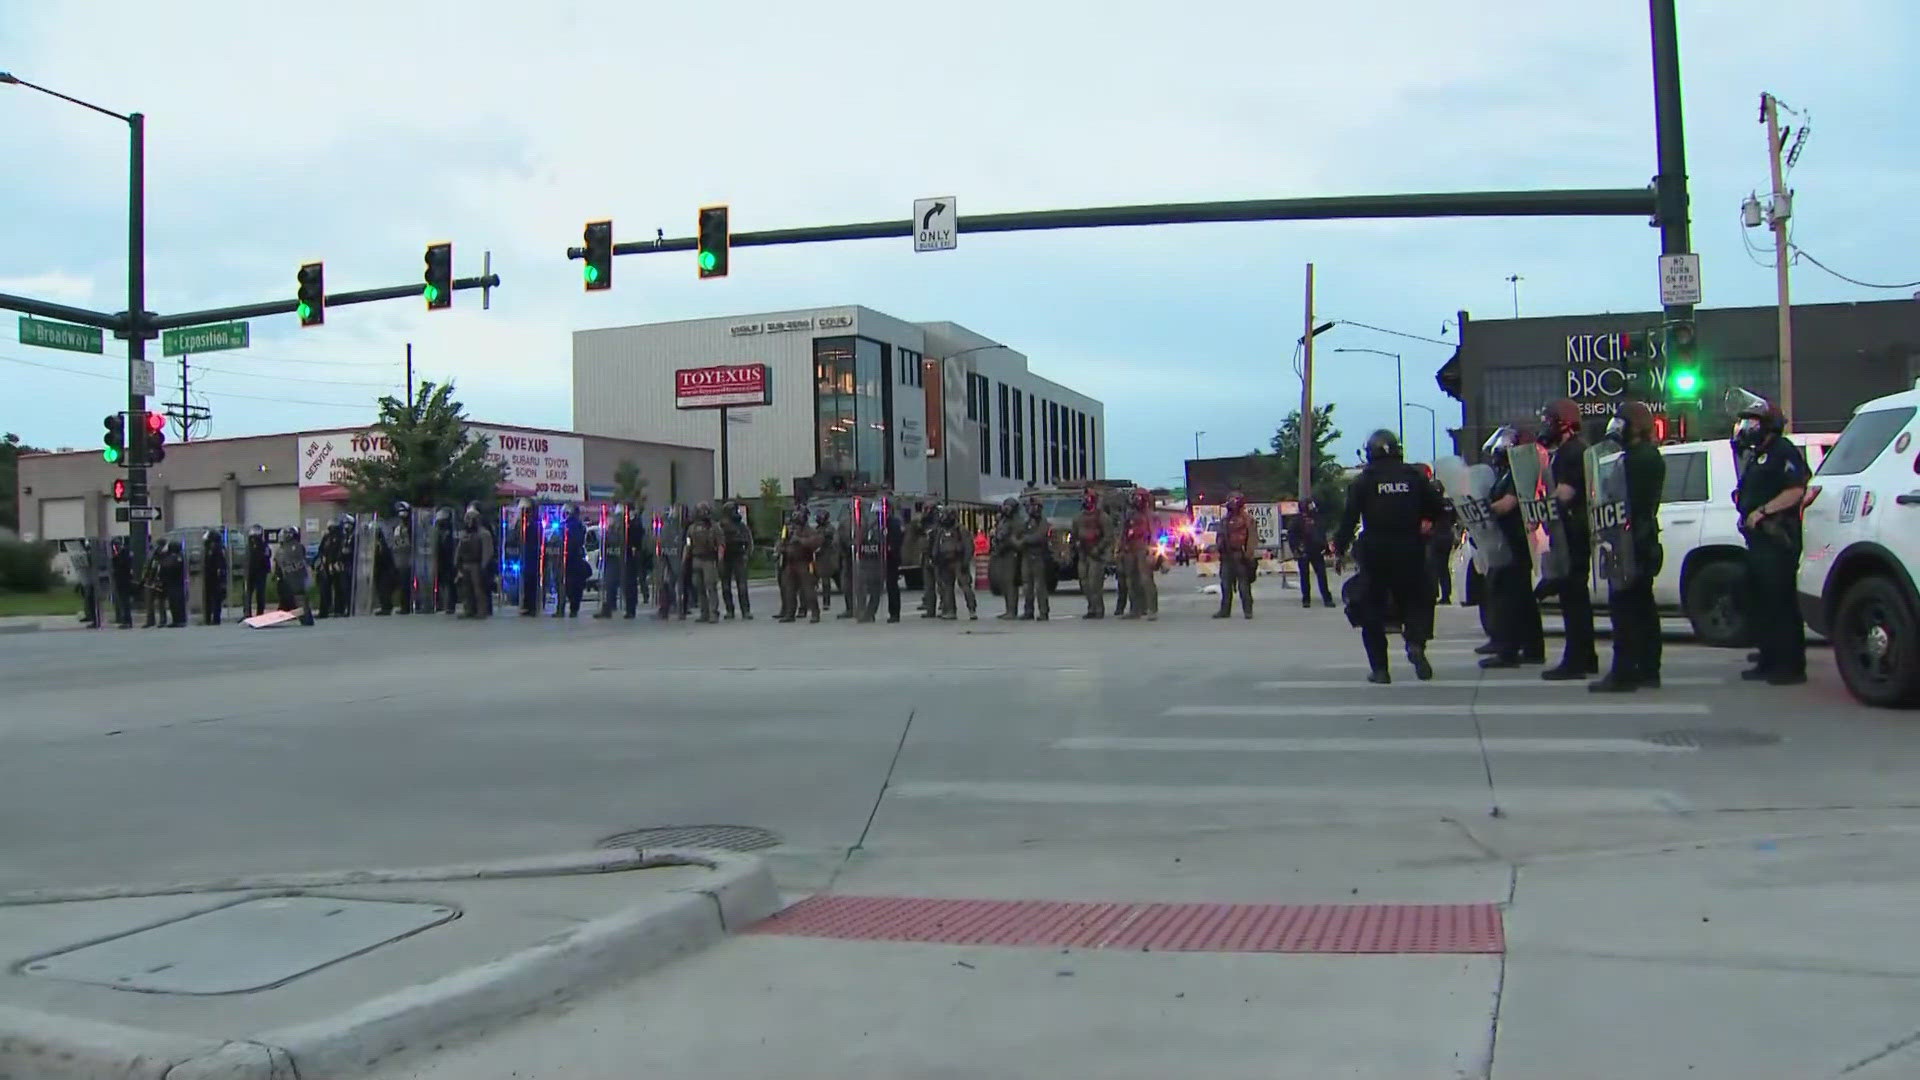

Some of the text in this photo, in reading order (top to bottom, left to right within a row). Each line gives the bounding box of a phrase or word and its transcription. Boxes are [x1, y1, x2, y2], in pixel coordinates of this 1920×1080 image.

[920, 230, 950, 242] ONLY
[37, 325, 89, 350] Broadway
[180, 331, 228, 352] Exposition
[1566, 331, 1657, 363] KITCHS
[680, 367, 761, 386] TOYEXUS
[499, 436, 548, 453] TOYEXUS
[305, 441, 334, 480] SERVICE
[512, 455, 540, 467] SUBARU
[544, 457, 569, 469] TOYOTA
[545, 469, 568, 480] LEXUS
[1377, 482, 1409, 494] POLICE
[1460, 501, 1491, 524] LICE
[1524, 499, 1559, 523] LICE
[1591, 500, 1628, 533] LICE
